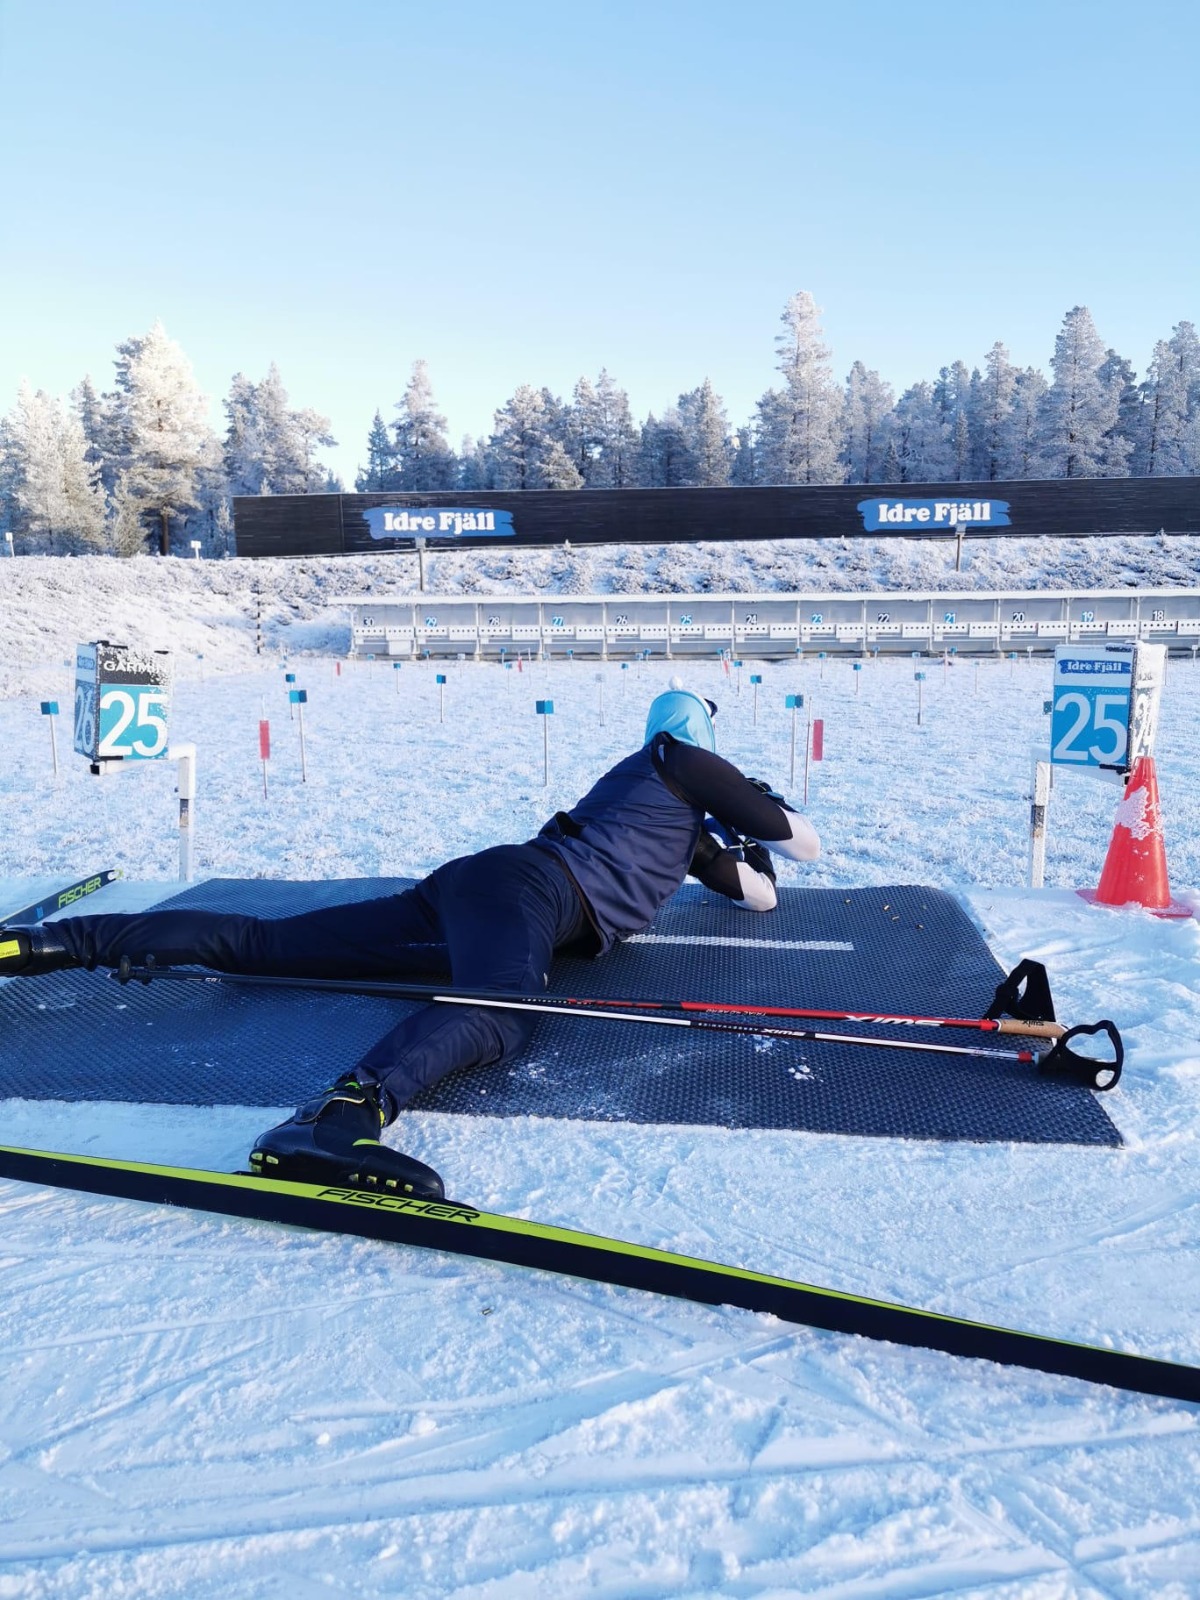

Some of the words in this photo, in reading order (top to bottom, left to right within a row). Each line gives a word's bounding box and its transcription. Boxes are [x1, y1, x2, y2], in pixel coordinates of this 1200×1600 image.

[878, 503, 931, 522] Idre
[934, 502, 991, 526] Fjäll
[384, 512, 435, 531] Idre
[439, 511, 495, 535] Fjäll
[552, 616, 564, 626] 27
[616, 615, 628, 625] 26
[680, 615, 692, 625] 25
[746, 614, 757, 624] 24
[813, 614, 823, 624] 23
[878, 613, 890, 622] 22
[944, 613, 956, 624] 21
[1013, 612, 1025, 623] 20
[1082, 611, 1094, 622] 19
[1153, 610, 1164, 621] 18
[363, 616, 375, 627] 30
[425, 616, 437, 627] 29
[489, 616, 501, 627] 28
[1067, 661, 1092, 671] Idre
[1094, 661, 1122, 673] Fjäll
[99, 690, 168, 757] 25
[1053, 692, 1128, 764] 25
[58, 876, 102, 909] FISCHER
[316, 1188, 481, 1222] FISCHER
